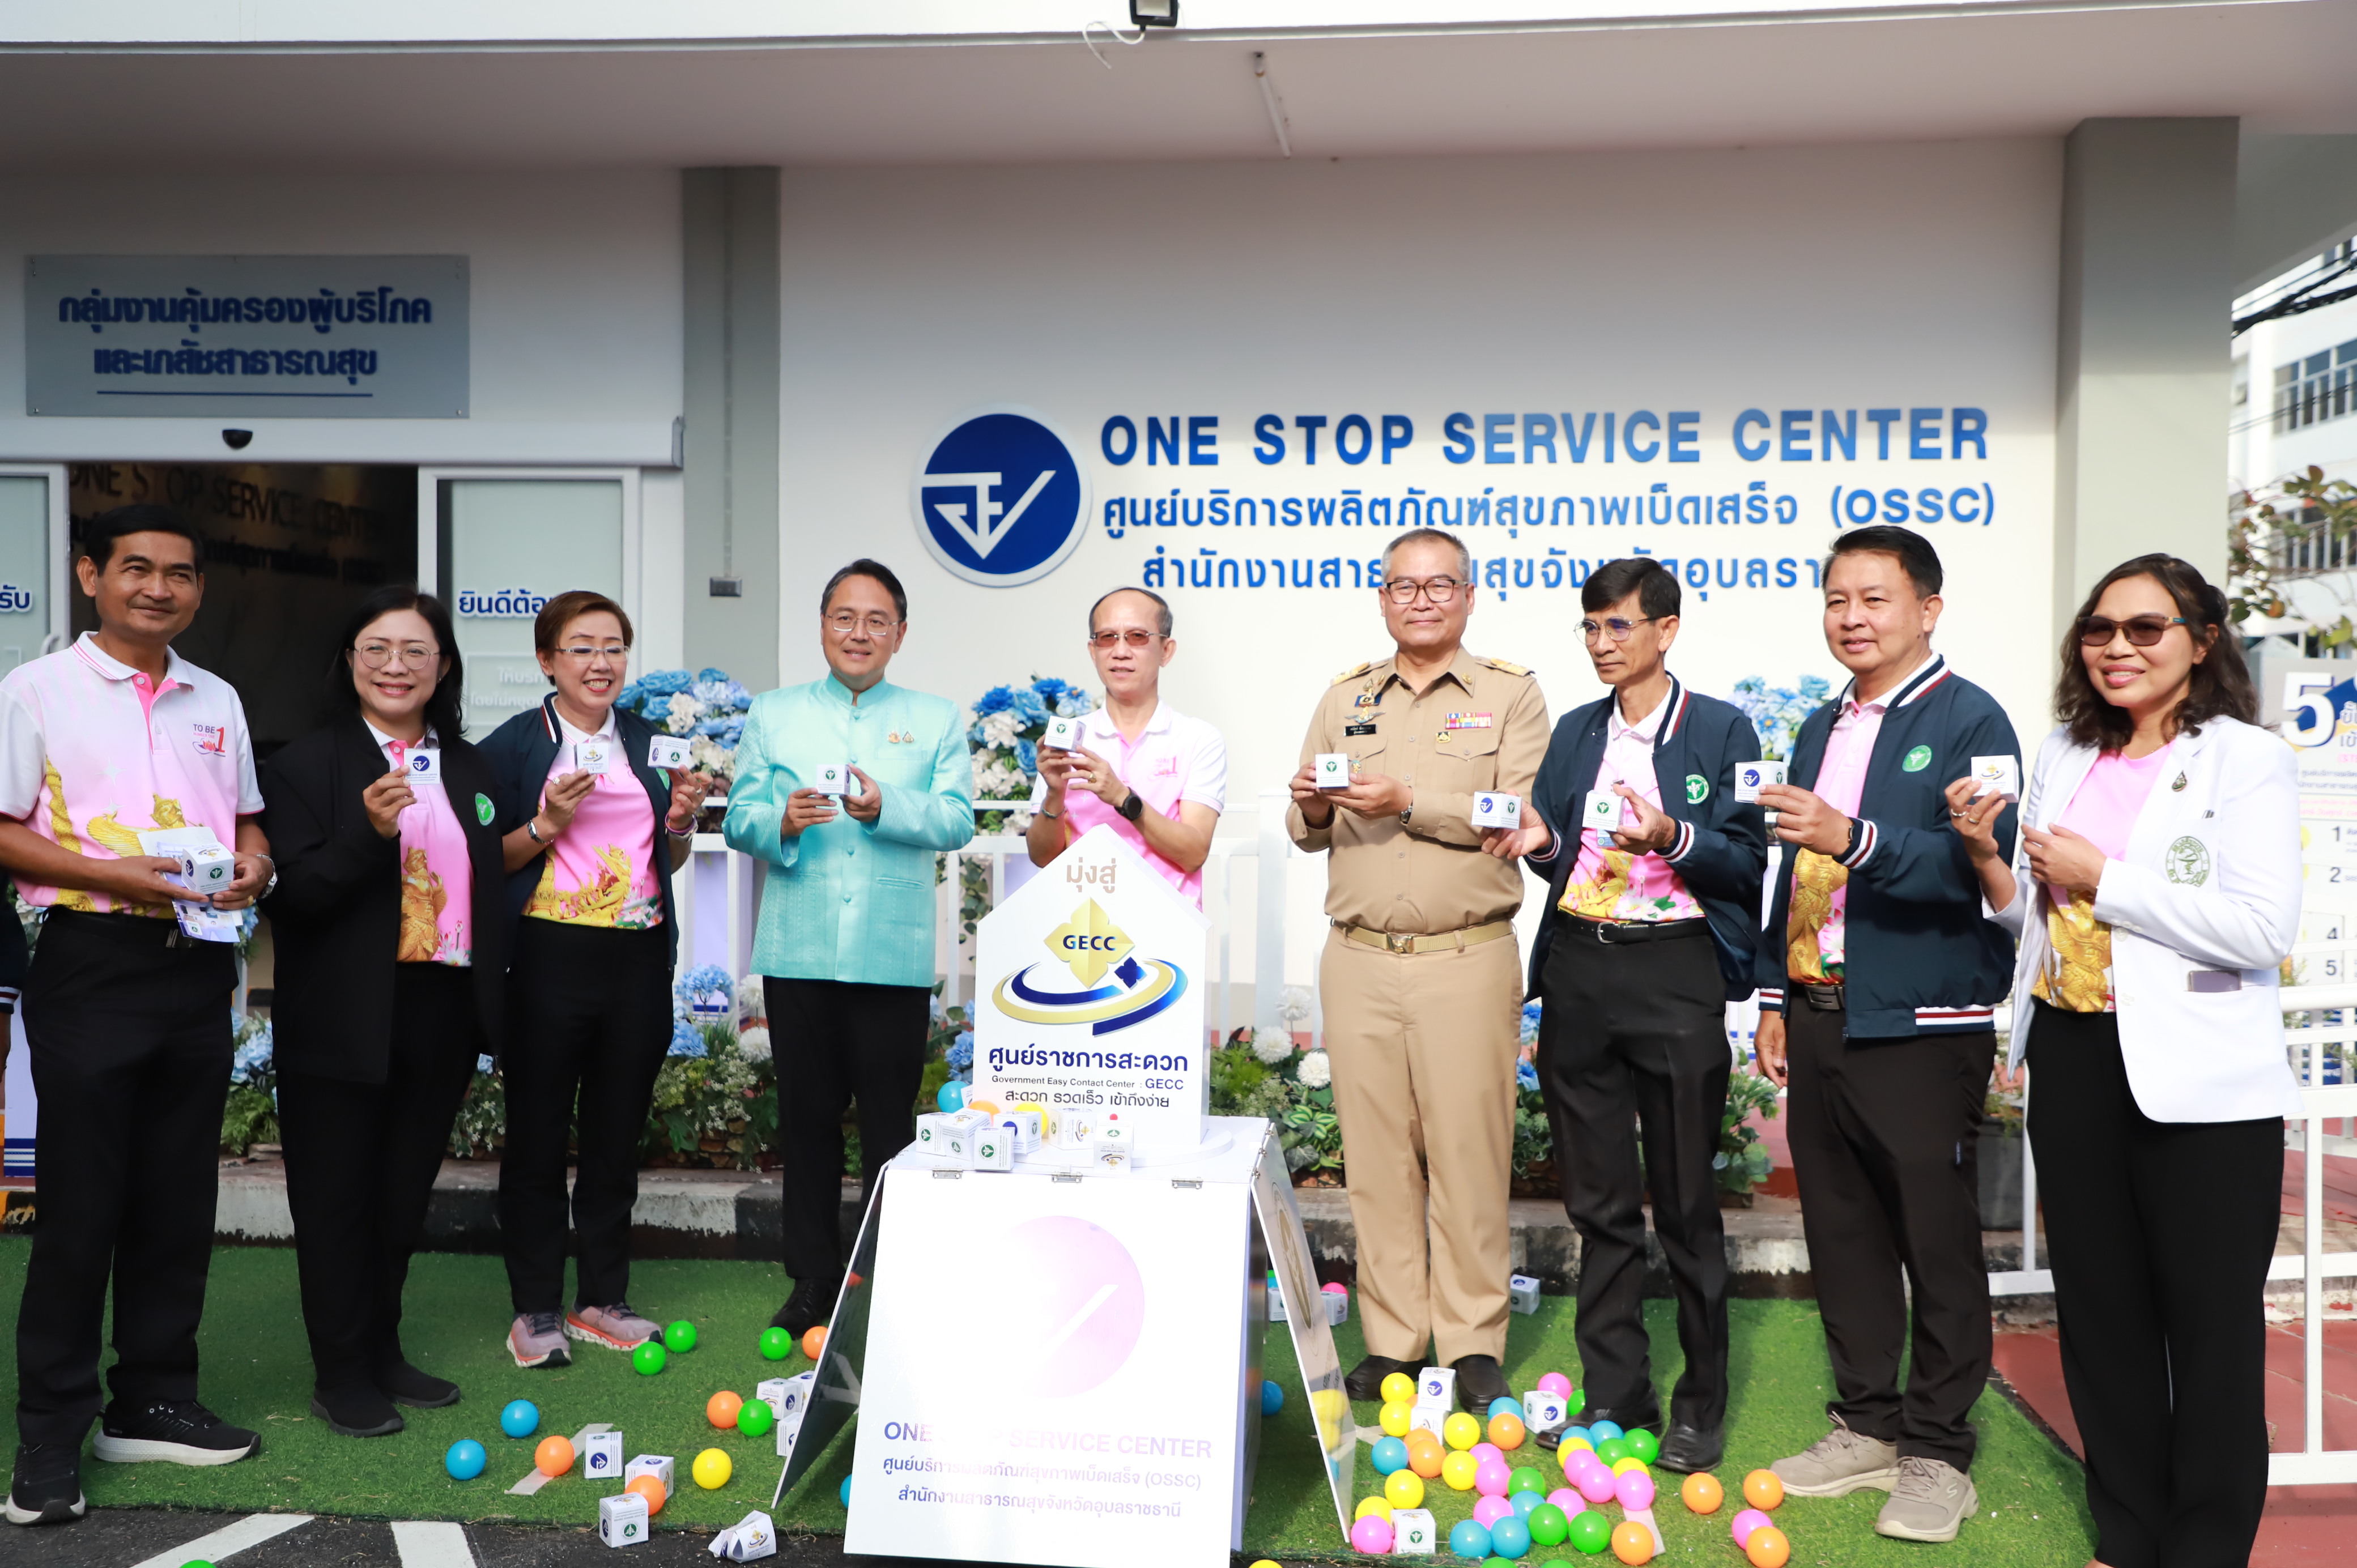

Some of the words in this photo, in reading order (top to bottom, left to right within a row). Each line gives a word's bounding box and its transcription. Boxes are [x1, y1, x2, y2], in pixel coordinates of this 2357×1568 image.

[59, 286, 432, 334] กลุ่มงานคุ้มครองผู้บริโภค
[93, 339, 378, 385] และเภสัชสาธารณสุข
[1101, 415, 1220, 466] ONE
[1253, 414, 1414, 465] STOP
[1443, 410, 1701, 465] SERVICE
[1733, 407, 1988, 462] CENTER
[1104, 481, 1798, 539] ศูนย์บริการผลิตภัณฑ์สุขภาพเบ็ดเสร็จ
[1831, 482, 1995, 528] (OSSC)
[2282, 672, 2335, 748] 5
[193, 723, 203, 732] TO
[216, 726, 226, 753] 1
[2330, 825, 2341, 842] 1
[1066, 856, 1117, 894] มุ่งสู่
[2329, 866, 2342, 883] 2
[1062, 934, 1117, 952] GECC
[2325, 960, 2337, 976] 5
[989, 1042, 1189, 1072] ศูนย์ราชการสะดวก
[992, 1075, 1045, 1085] Government
[1048, 1077, 1067, 1087] Easy
[1070, 1079, 1104, 1087] Contact
[1106, 1080, 1135, 1088] Center
[1145, 1078, 1184, 1090] GECC
[1005, 1090, 1048, 1102] สะดวก
[1053, 1089, 1104, 1105] รวดเร็ว
[1110, 1092, 1170, 1107] เข้าถึงง่าย
[883, 1421, 934, 1442] ONE
[1009, 1429, 1111, 1452] SERVICE
[1117, 1434, 1212, 1458] CENTER
[1145, 1471, 1202, 1491] (OSSC)
